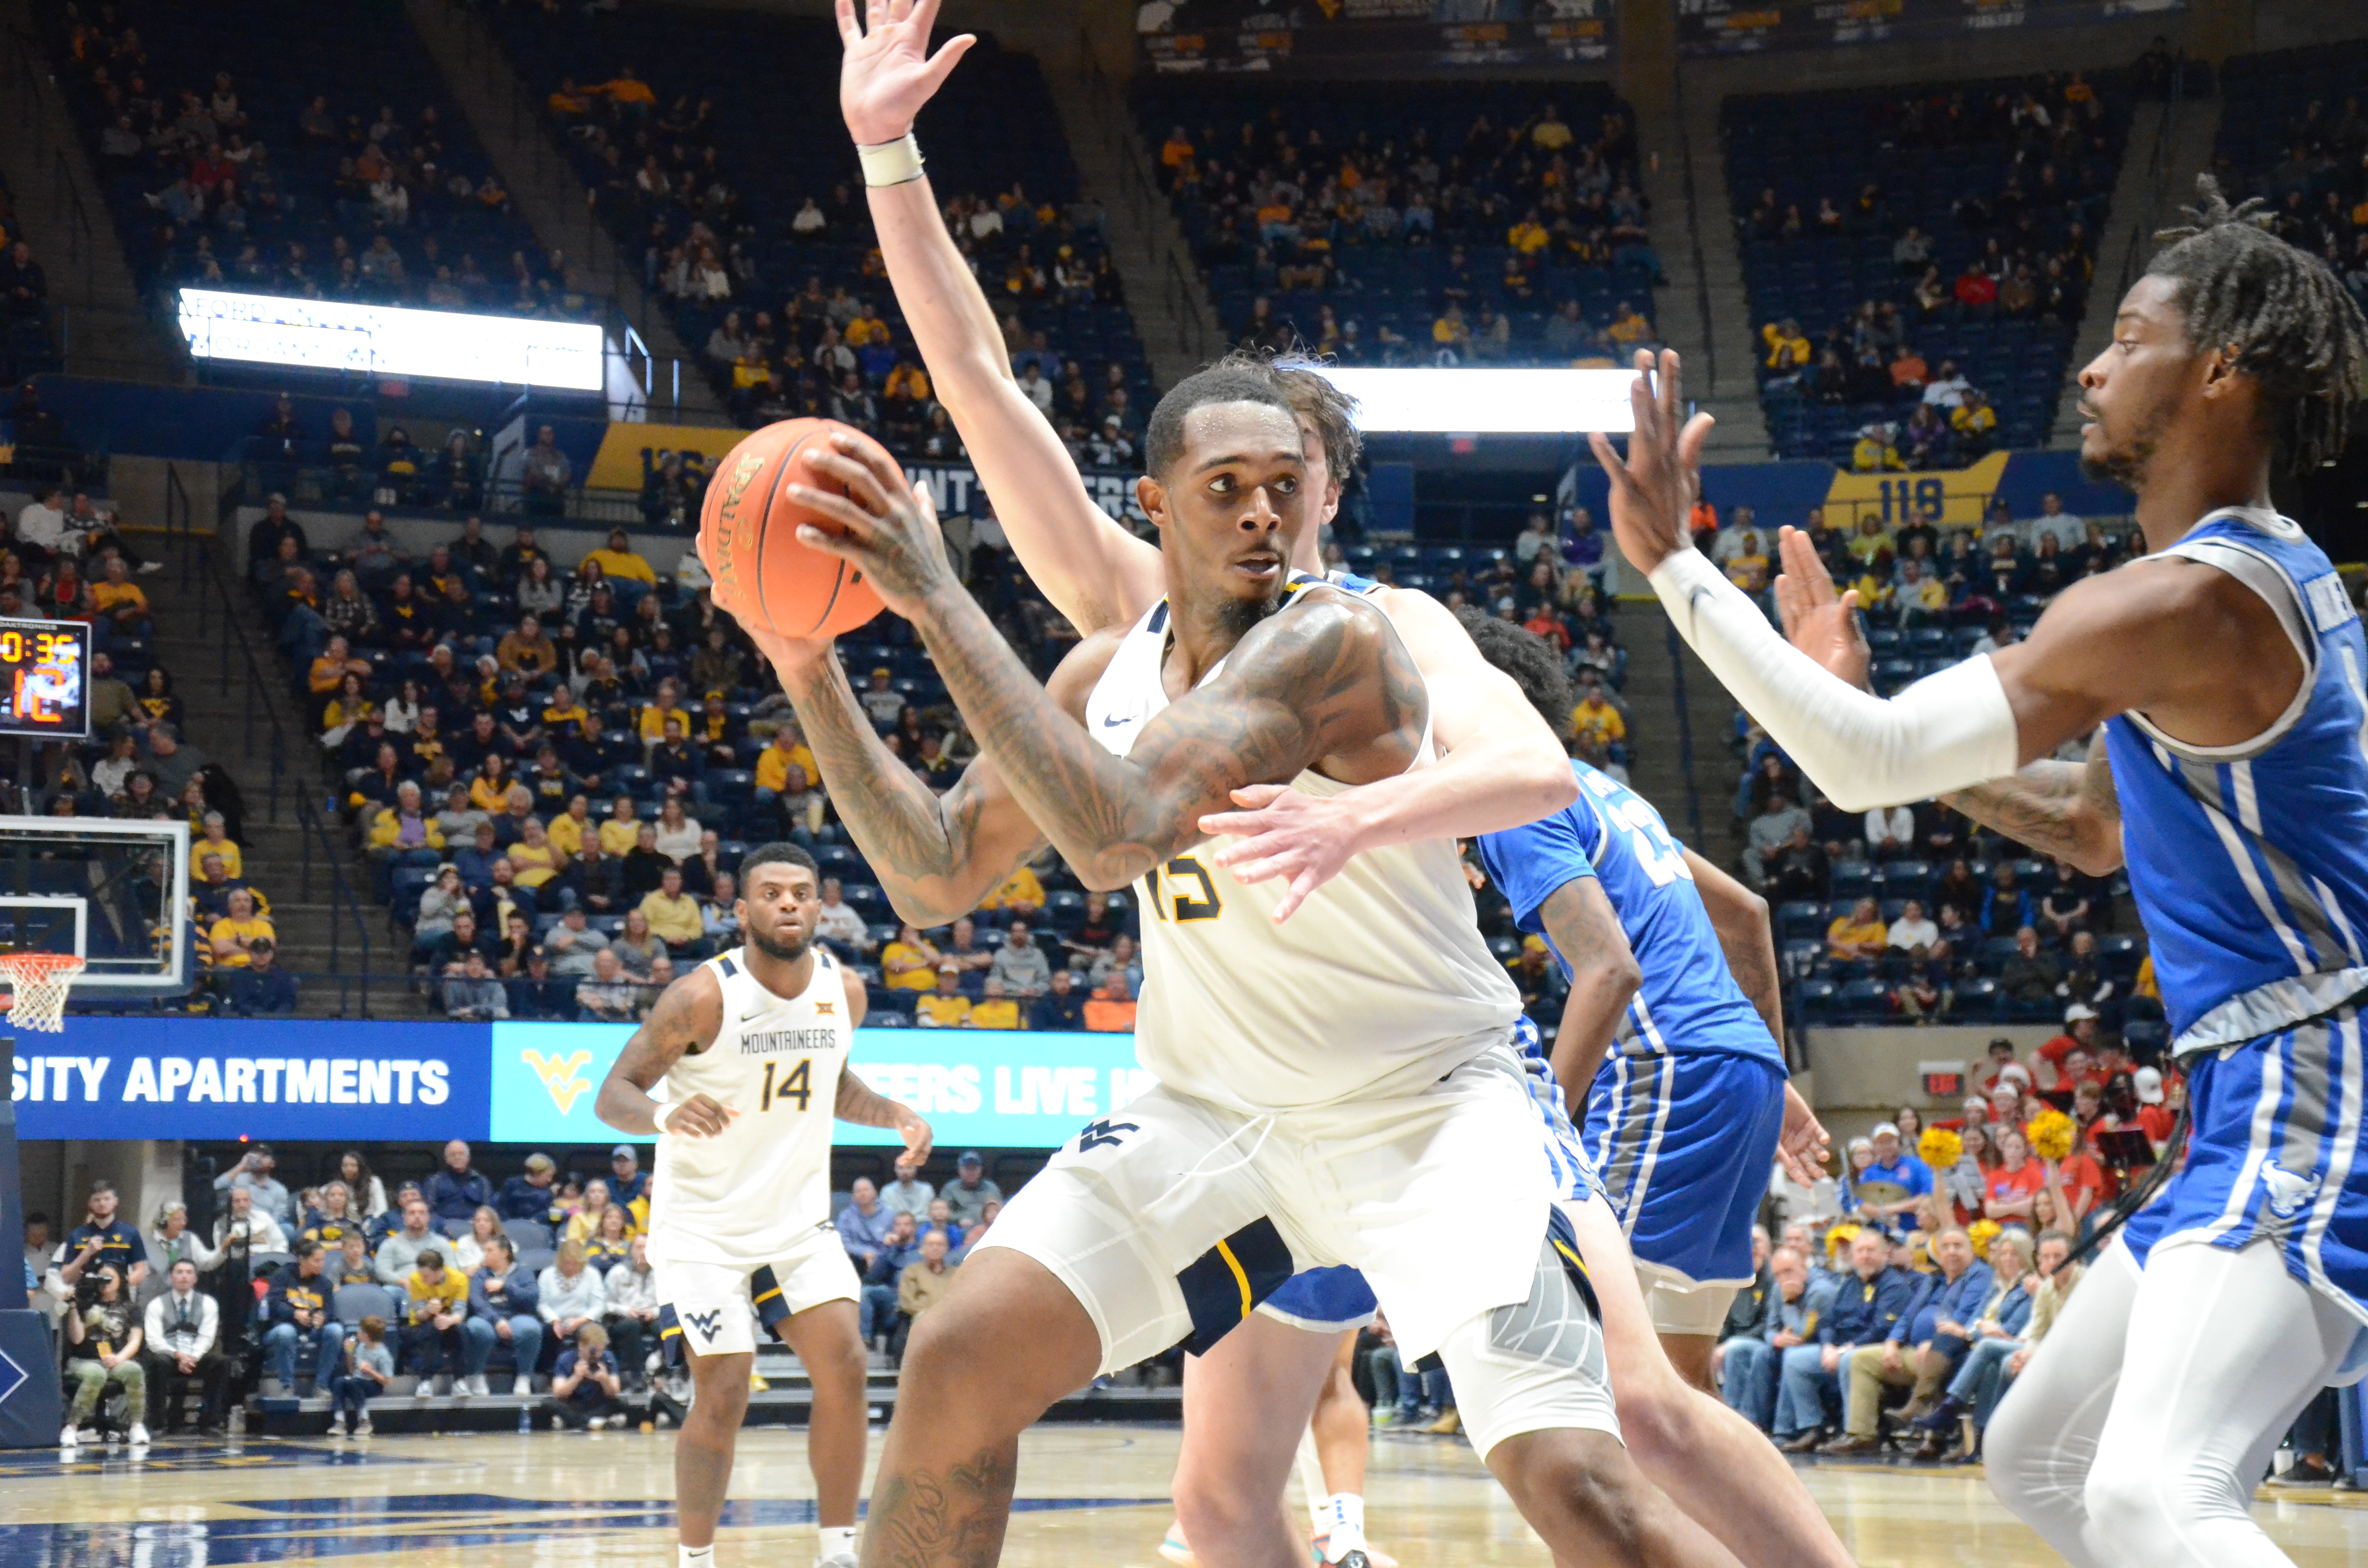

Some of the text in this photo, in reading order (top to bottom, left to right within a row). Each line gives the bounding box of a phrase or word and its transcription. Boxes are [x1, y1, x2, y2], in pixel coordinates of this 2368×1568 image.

[1879, 479, 1944, 522] 118
[716, 453, 765, 598] SPALDING
[0, 631, 76, 665] 0:35
[740, 1029, 835, 1054] MOUNTAINEERS
[122, 1057, 450, 1105] APARTMENTS
[760, 1058, 812, 1112] 14
[995, 1066, 1098, 1115] LIVE
